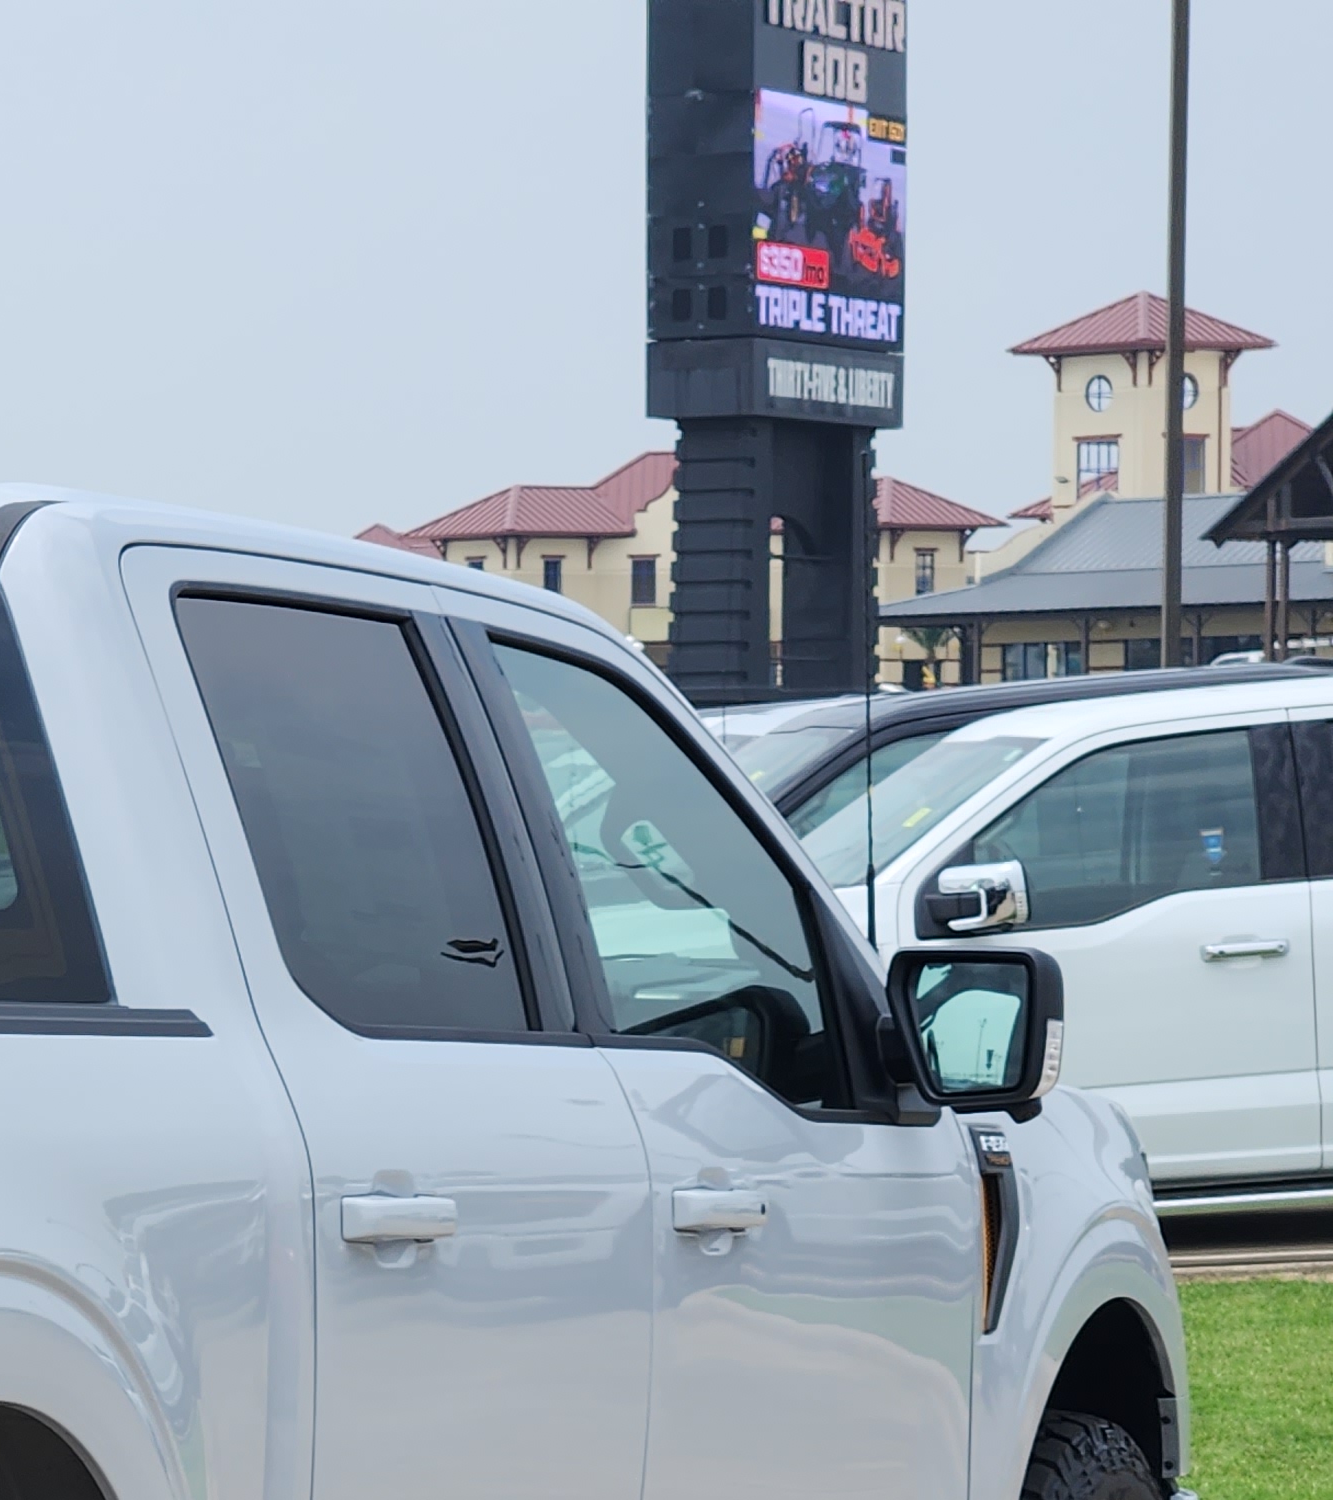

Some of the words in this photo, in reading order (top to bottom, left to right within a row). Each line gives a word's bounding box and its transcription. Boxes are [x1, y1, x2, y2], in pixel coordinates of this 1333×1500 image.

[803, 39, 868, 104] BOB
[755, 284, 826, 333] TRIPLE
[828, 293, 902, 342] THREAT
[848, 367, 895, 409] LIBERTY
